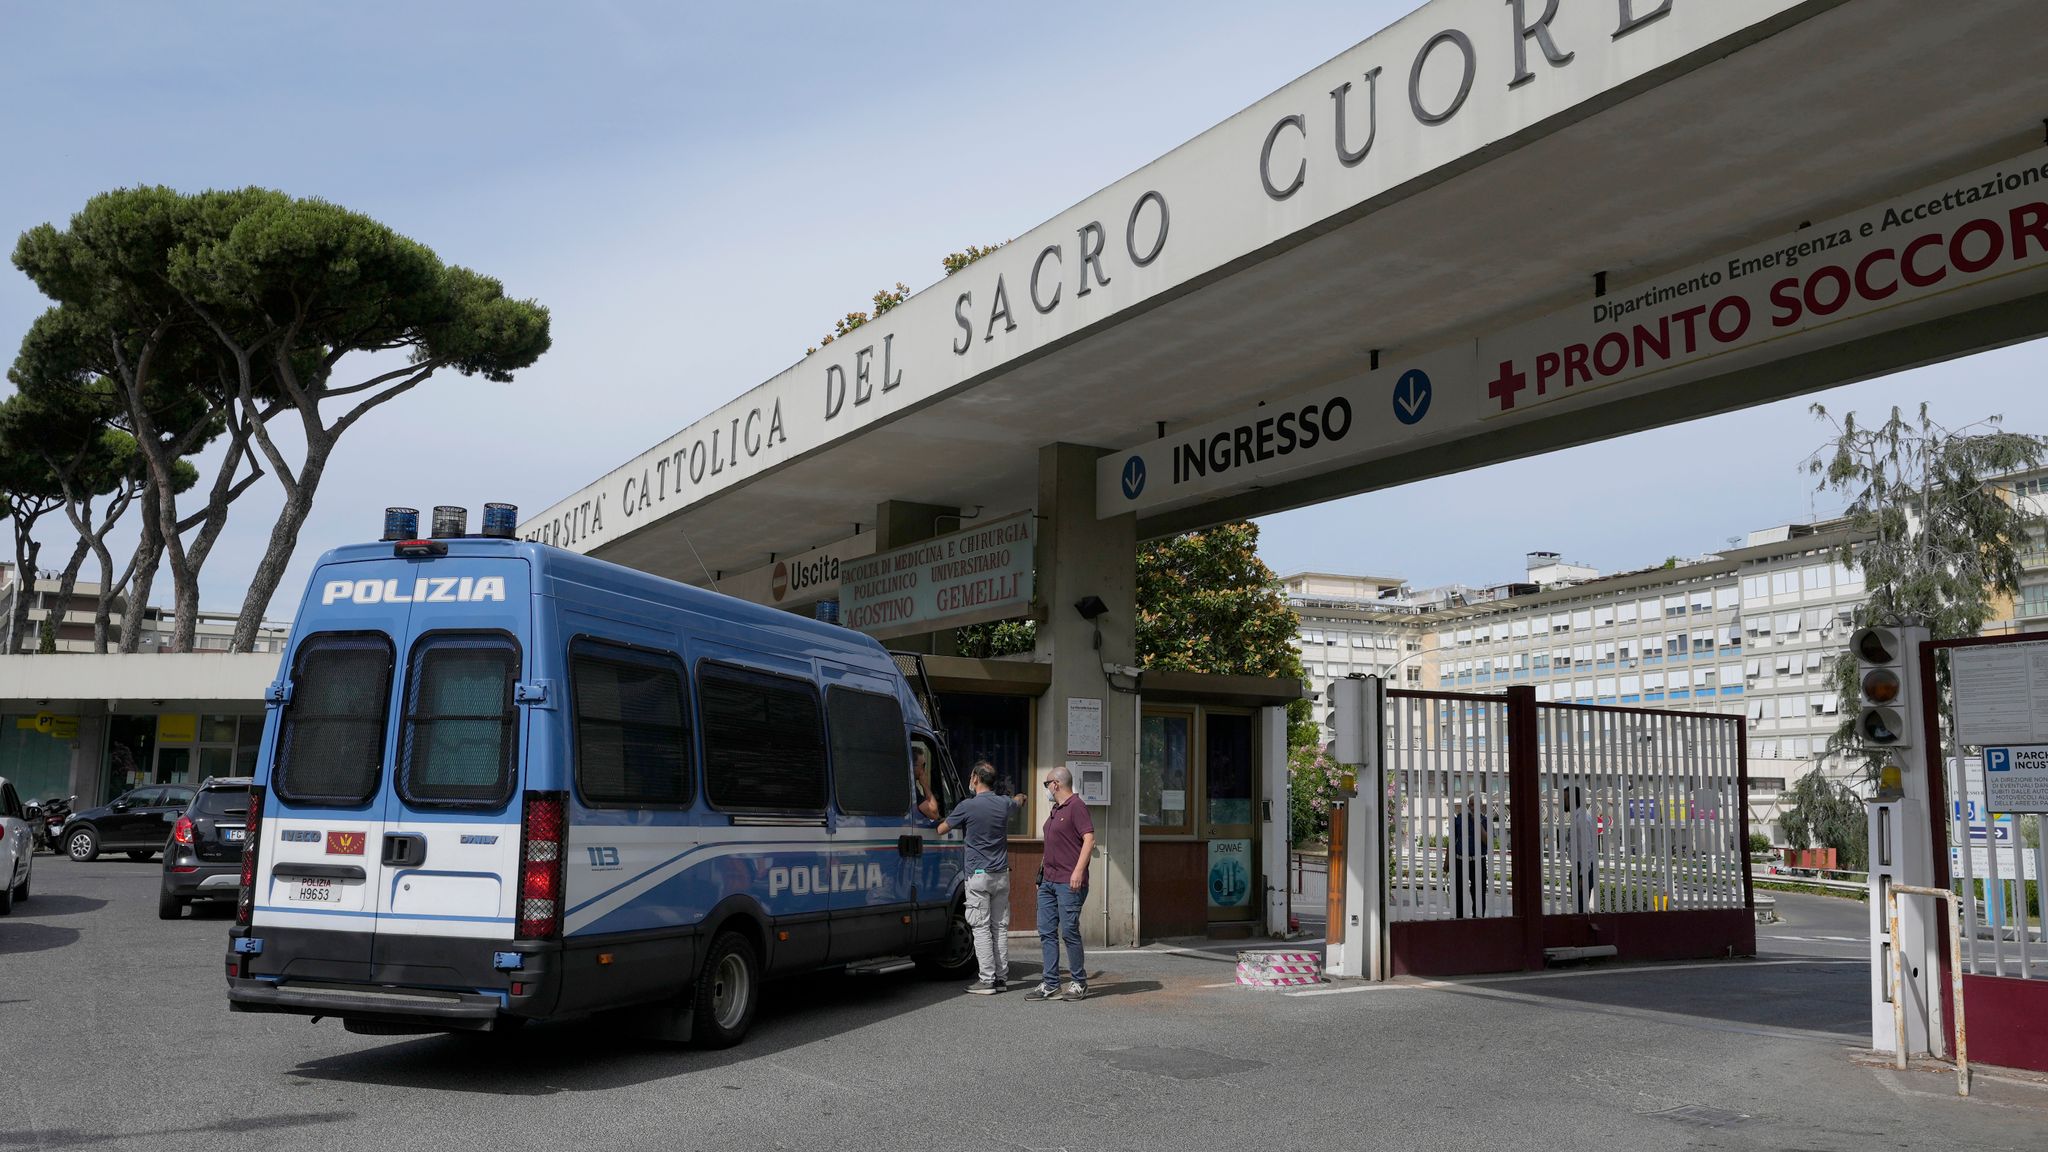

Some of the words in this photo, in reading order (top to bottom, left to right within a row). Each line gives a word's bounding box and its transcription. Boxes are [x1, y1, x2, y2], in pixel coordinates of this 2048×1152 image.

[1593, 270, 1722, 324] Dipartimento
[1728, 228, 1852, 280] Emergenza
[1859, 221, 1874, 238] e
[622, 396, 788, 518] CATTOLICA
[824, 333, 903, 421] DEL
[953, 190, 1170, 355] SACRO
[1536, 296, 1751, 396] PRONTO
[1173, 396, 1352, 484] INGRESSO
[841, 562, 880, 585] FACOLTA
[881, 558, 891, 575] DI
[895, 544, 943, 572] MEDICINA
[948, 541, 955, 558] E
[960, 521, 1029, 554] CHIRURGIA
[321, 575, 506, 606] POLIZIA
[791, 554, 839, 591] Uscita
[854, 572, 917, 601] POLICLINICO
[931, 549, 1010, 583] UNIVERSITARIO
[1991, 751, 2005, 769] P
[281, 829, 322, 843] IVECO
[587, 846, 620, 866] 113
[300, 887, 330, 901] H9653
[301, 877, 331, 888] POLIZIA
[768, 862, 884, 898] POLIZIA
